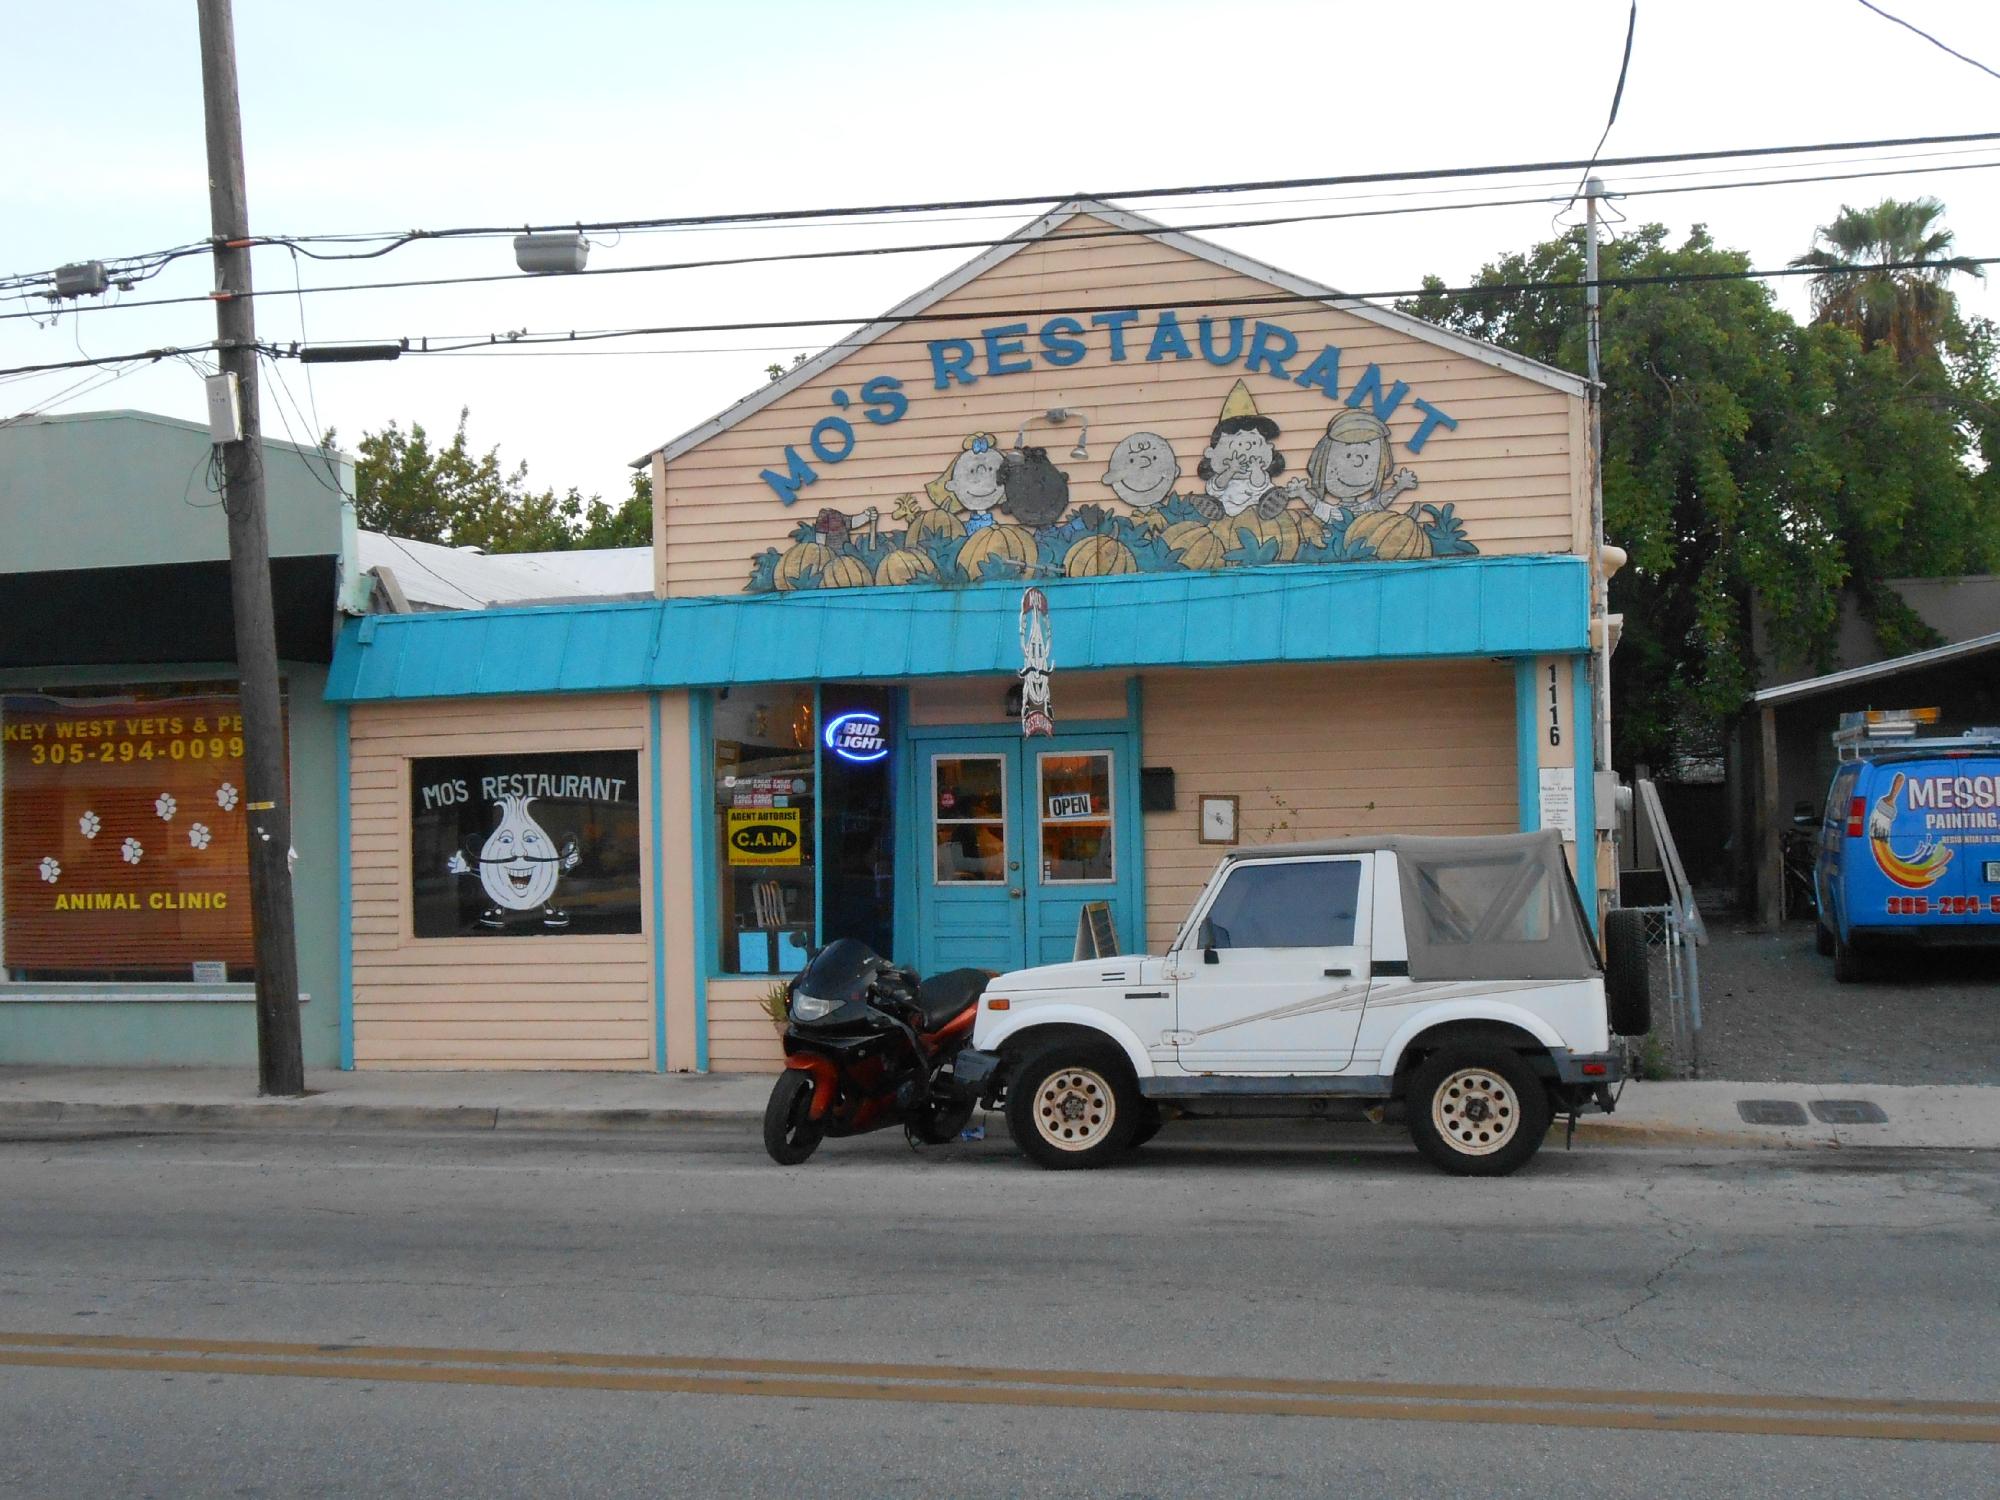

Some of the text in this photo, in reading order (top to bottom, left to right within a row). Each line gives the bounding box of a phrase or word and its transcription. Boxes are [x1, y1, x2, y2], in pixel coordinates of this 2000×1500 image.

[759, 309, 1458, 508] MO'S RESTAURANT
[1548, 664, 1560, 746] 1116
[3, 715, 243, 741] KEY WEST VETS & PE
[843, 722, 880, 736] BUD
[31, 736, 245, 764] 305-294-0099
[835, 735, 886, 750] LIGHT
[422, 773, 626, 810] MO'S RESTAURANT
[731, 811, 756, 821] AGENT
[1053, 796, 1088, 817] OPEN
[736, 831, 793, 847] C.A.M.
[54, 892, 227, 910] ANIMAL CLINIC
[1886, 895, 2000, 915] 305-294-5
